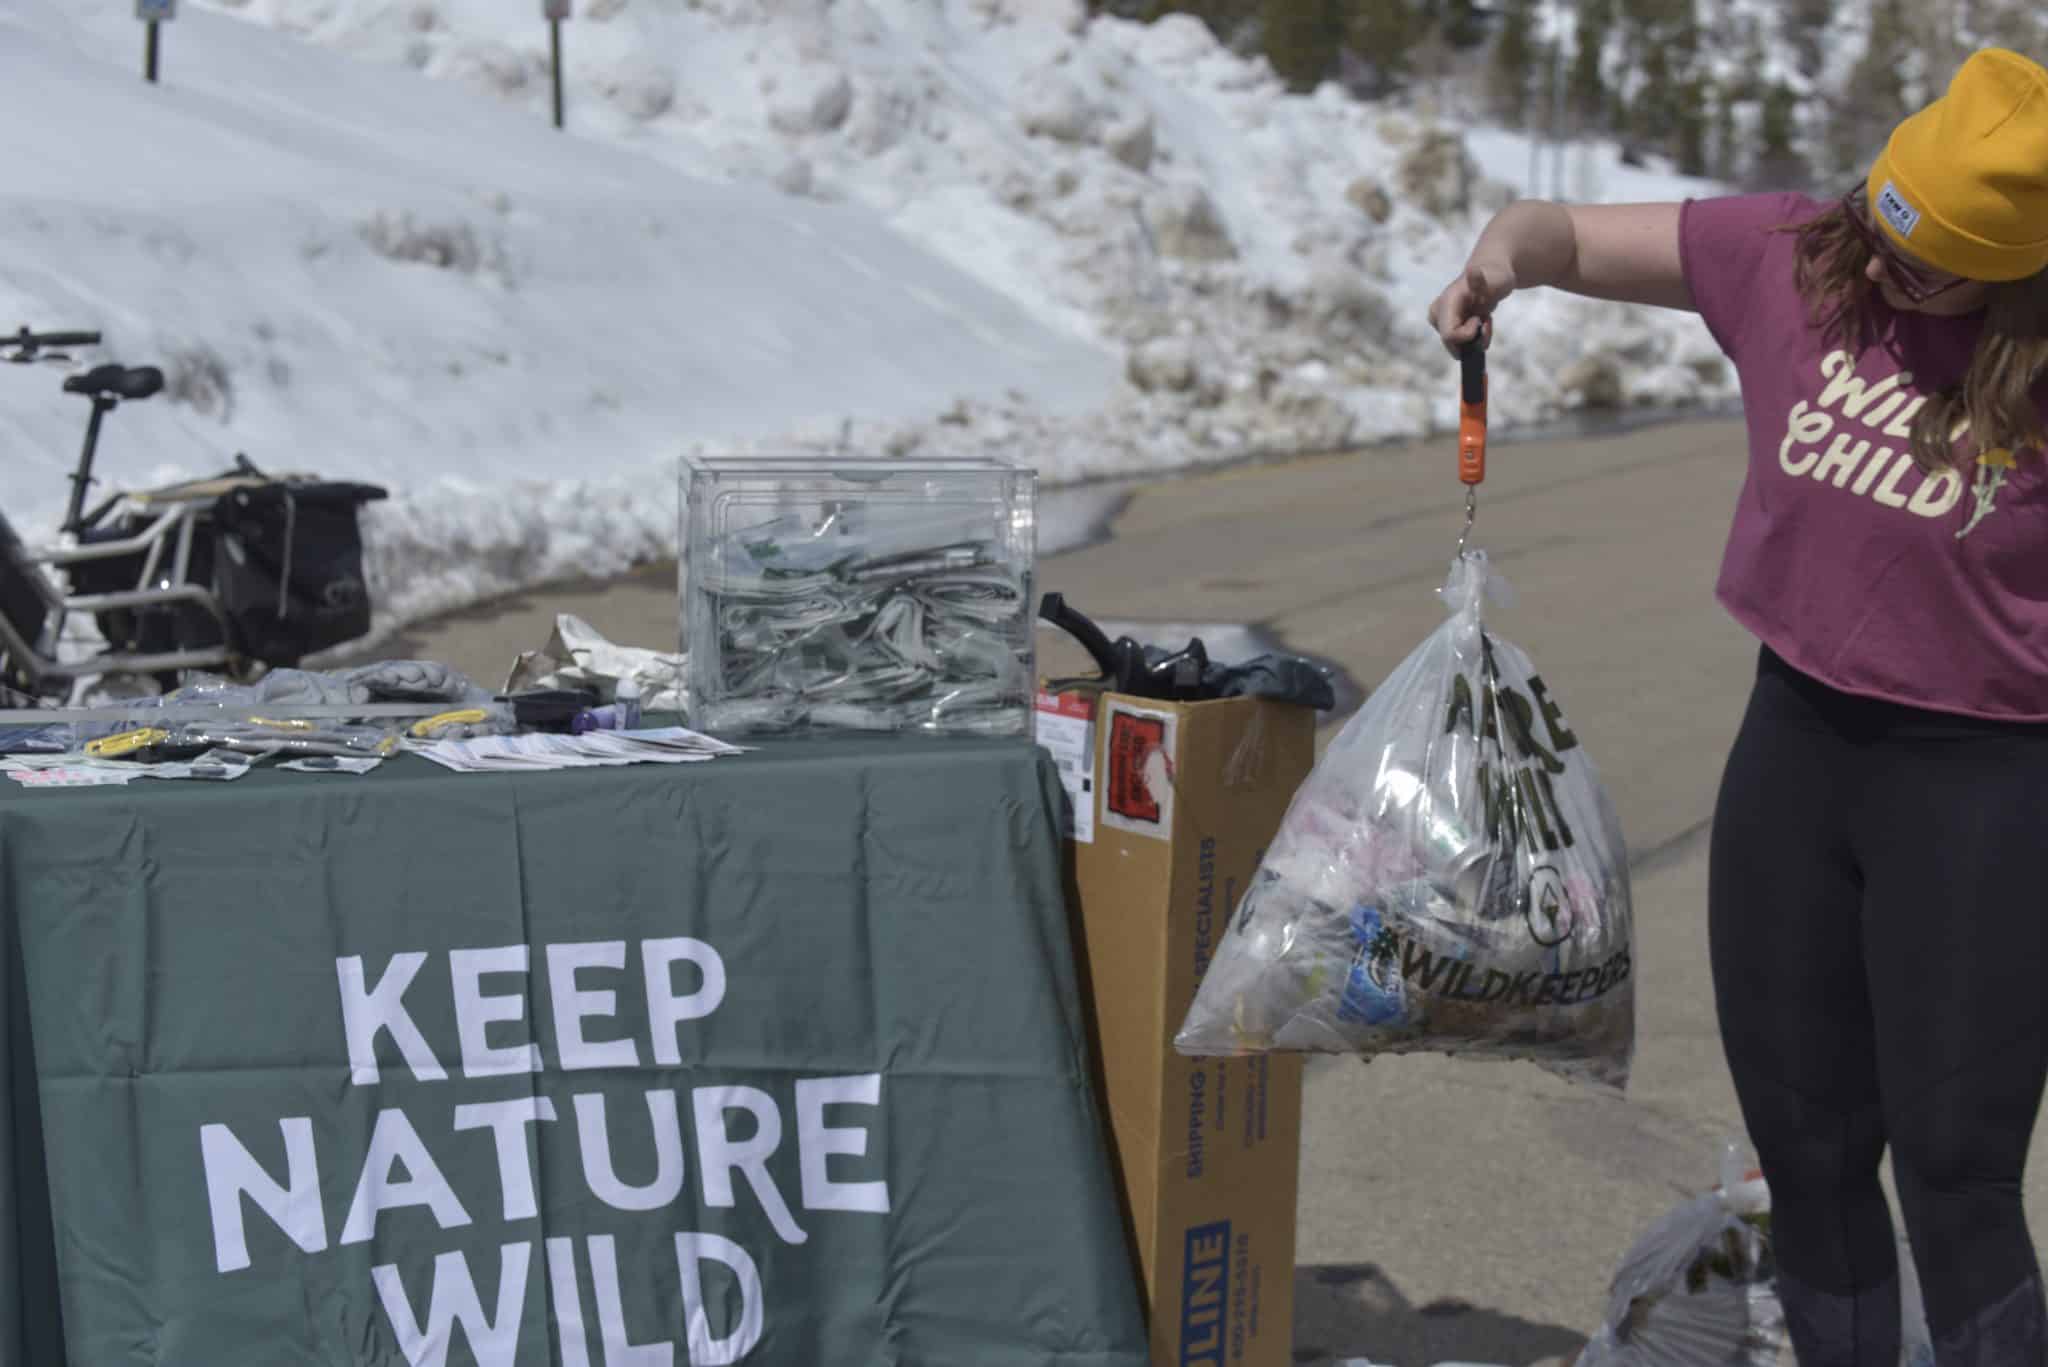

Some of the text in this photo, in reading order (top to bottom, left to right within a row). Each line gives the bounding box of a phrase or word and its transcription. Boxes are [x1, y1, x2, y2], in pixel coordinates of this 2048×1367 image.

[1779, 400, 1963, 517] CHILD
[1817, 350, 1972, 444] WIL
[336, 937, 727, 1086] KEEP
[200, 1073, 890, 1273] NATURE
[1187, 1071, 1206, 1180] SHIPPING
[371, 1231, 764, 1367] WILD
[1187, 1231, 1224, 1367] LINE
